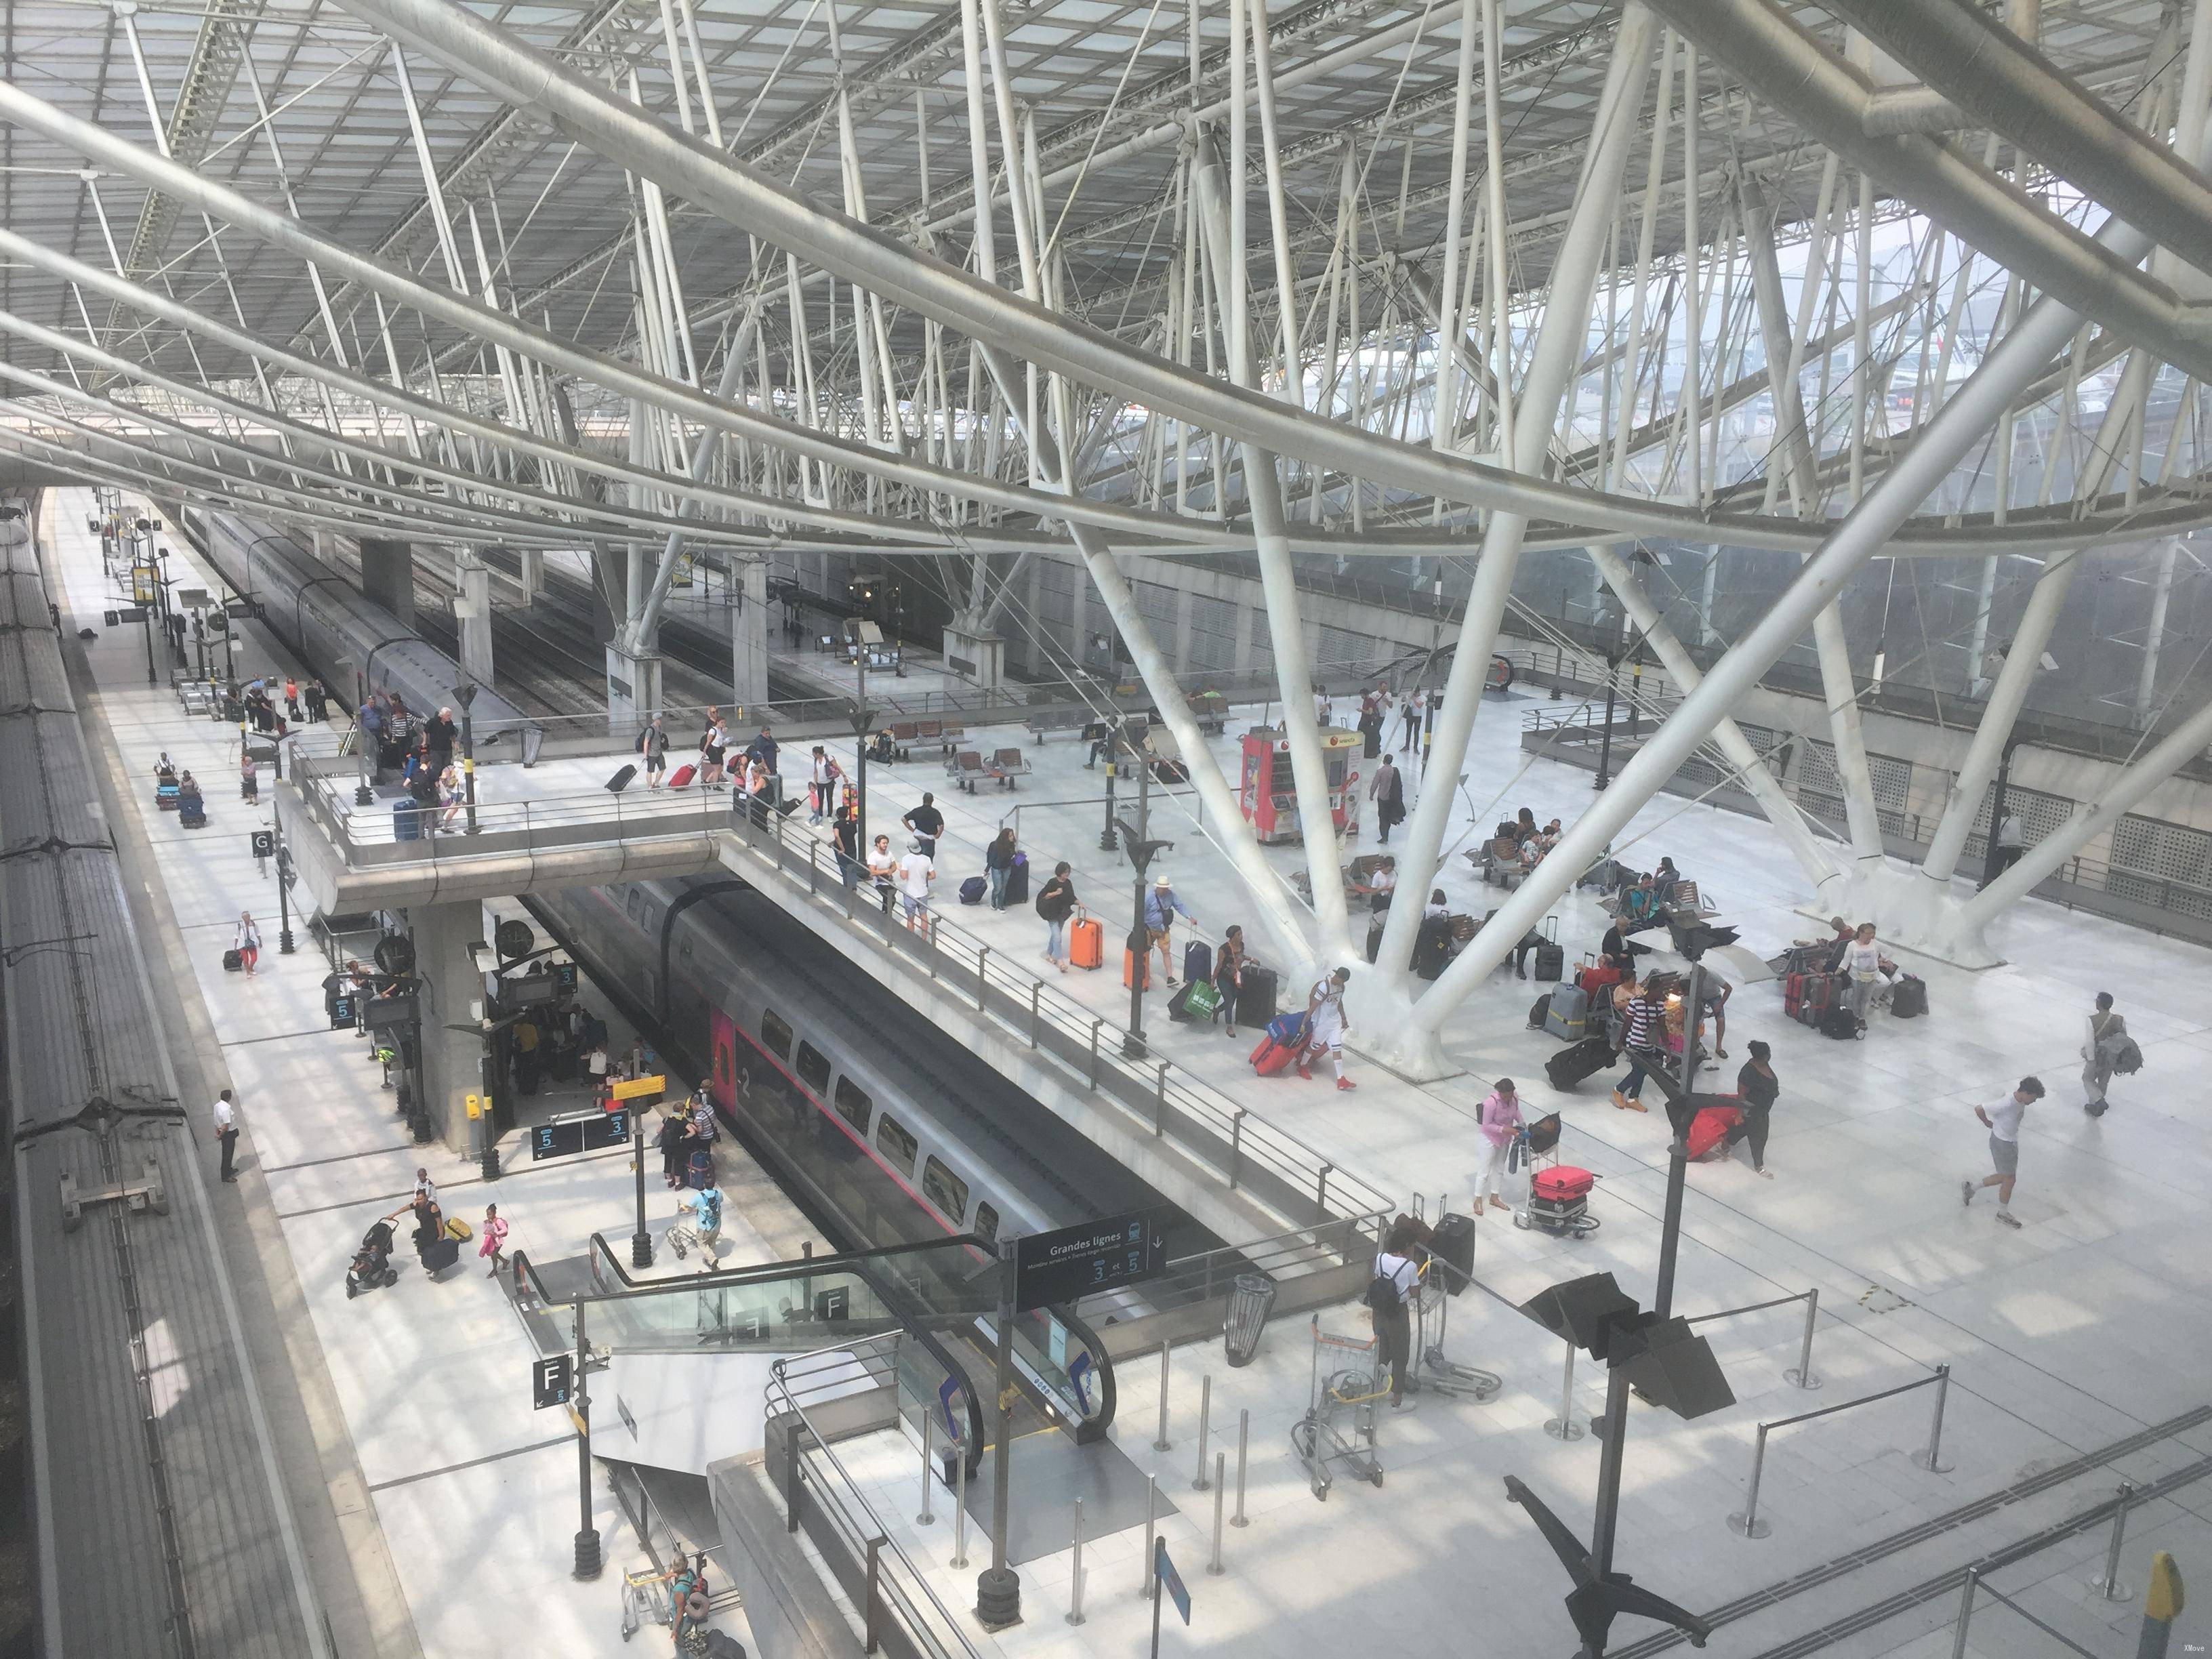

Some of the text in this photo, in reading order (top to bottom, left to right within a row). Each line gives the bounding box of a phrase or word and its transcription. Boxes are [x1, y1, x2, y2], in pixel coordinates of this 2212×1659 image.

[255, 835, 268, 848] G
[562, 972, 571, 983] 3
[338, 1004, 348, 1017] 5
[742, 1067, 750, 1099] 2
[613, 1121, 621, 1133] 3
[541, 1134, 552, 1147] 5
[1050, 1232, 1121, 1256] Grandes lignes
[1094, 1267, 1103, 1280] 3
[1129, 1257, 1138, 1271] 5
[828, 1296, 841, 1318] F
[545, 1366, 559, 1389] F
